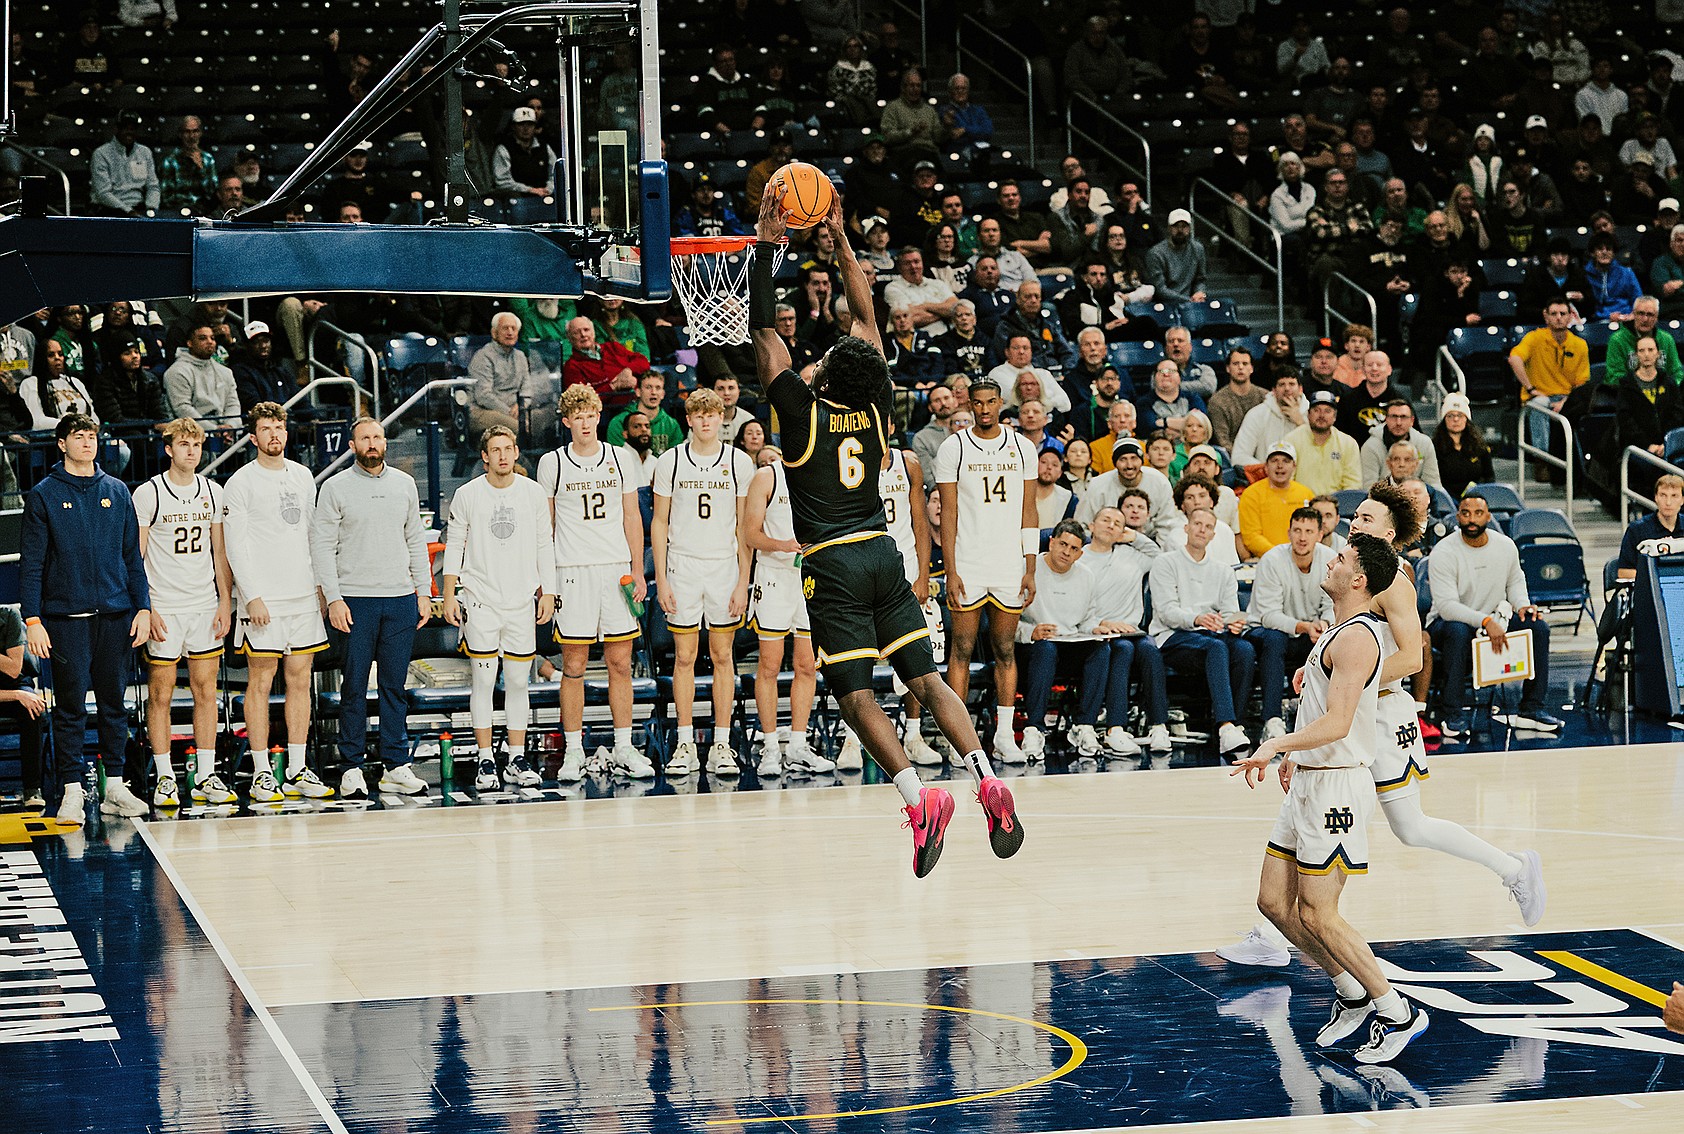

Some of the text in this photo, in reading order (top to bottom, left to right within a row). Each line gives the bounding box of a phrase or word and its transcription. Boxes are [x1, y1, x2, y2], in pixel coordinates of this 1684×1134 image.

[324, 432, 342, 452] 17
[837, 436, 865, 490] 6
[968, 463, 1018, 472] NOTRE DAME
[565, 479, 617, 492] NOTRE DAME
[678, 480, 730, 490] NOTRE DAME
[885, 483, 906, 494] DAME
[982, 475, 1006, 503] 14
[581, 492, 606, 520] 12
[697, 492, 712, 520] 6
[162, 513, 189, 524] NOTRE
[192, 511, 212, 521] DAME
[174, 525, 203, 555] 22
